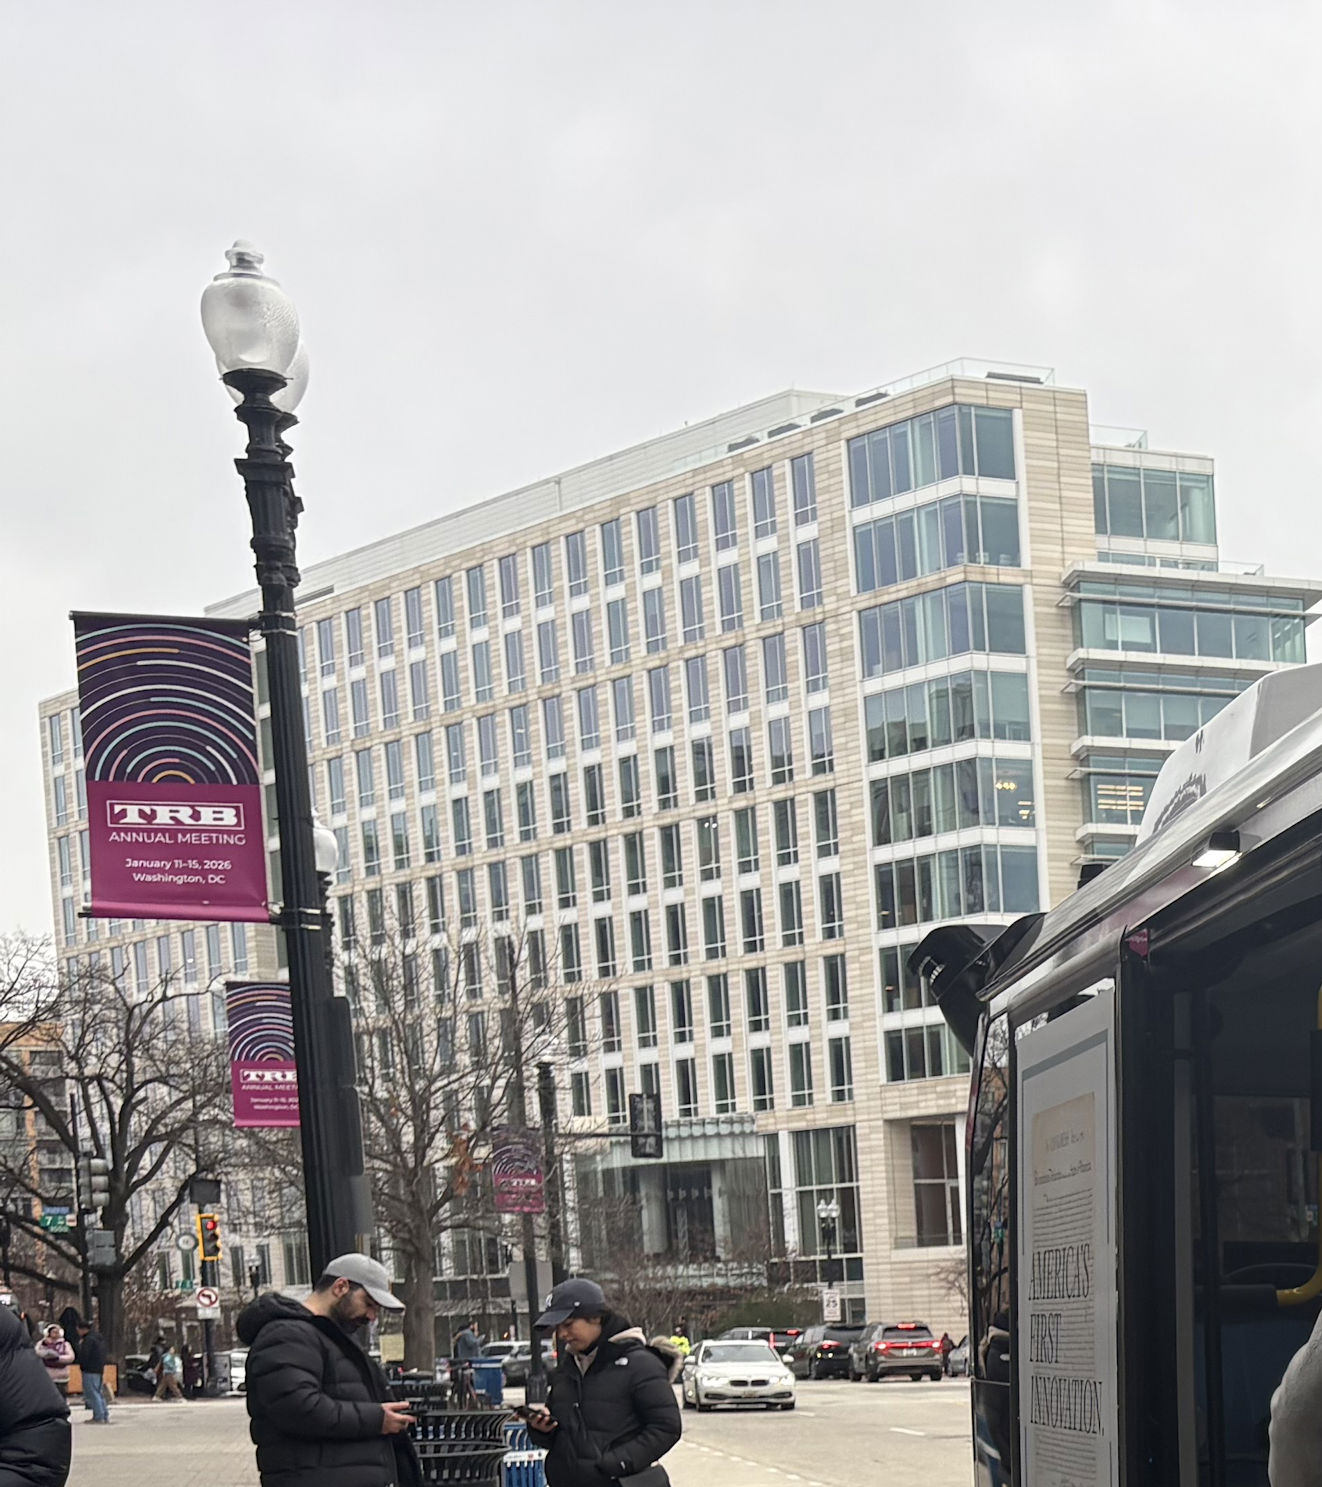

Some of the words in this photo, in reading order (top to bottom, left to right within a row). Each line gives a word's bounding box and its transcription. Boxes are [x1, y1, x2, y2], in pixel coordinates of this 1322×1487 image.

[113, 804, 238, 826] TRB
[109, 831, 174, 844] ANNUAL
[178, 833, 246, 846] MEETING
[125, 858, 172, 870] January
[203, 860, 232, 870] 2026
[133, 872, 206, 885] Washington,
[208, 874, 226, 884] DC
[1029, 1243, 1090, 1301] AMERICA'S
[1030, 1313, 1062, 1363] FIRST
[1030, 1375, 1105, 1436] INNOVATION.
